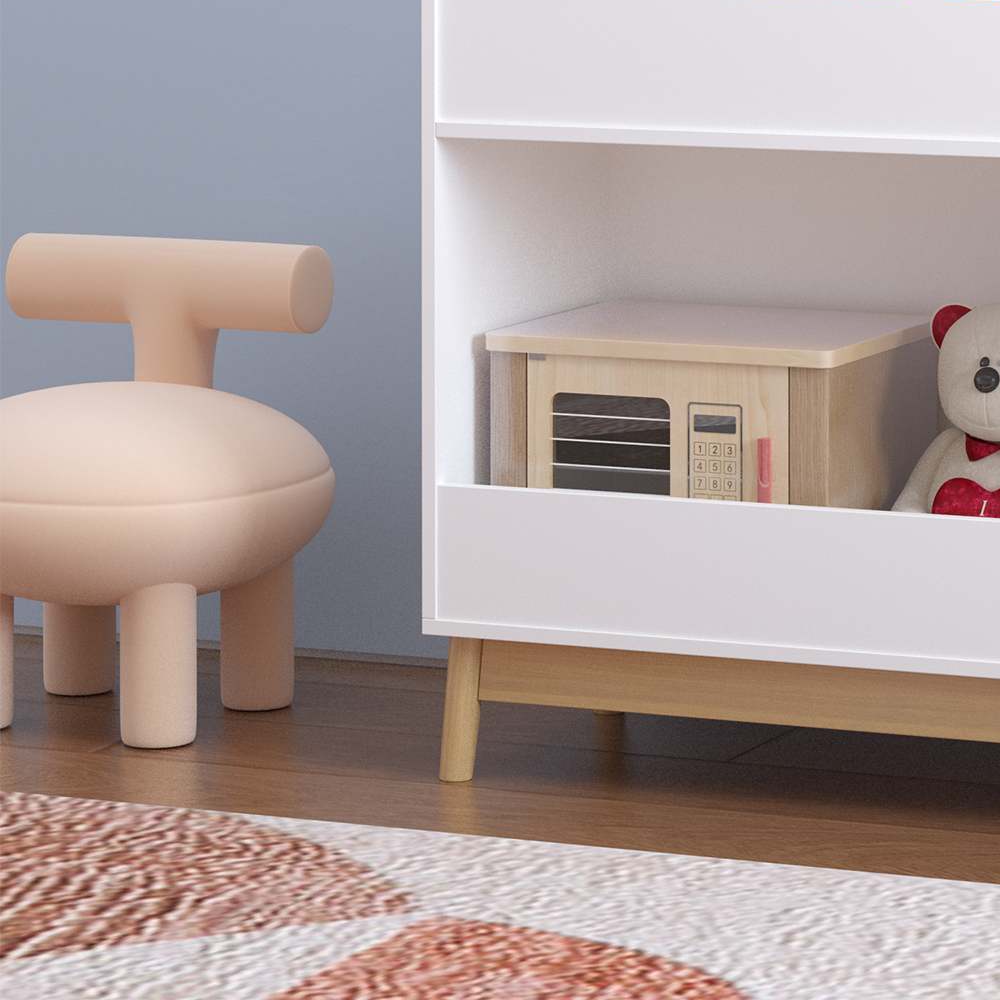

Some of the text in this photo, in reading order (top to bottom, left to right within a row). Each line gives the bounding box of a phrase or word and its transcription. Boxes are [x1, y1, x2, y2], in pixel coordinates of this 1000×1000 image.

[712, 446, 718, 454] 2
[727, 447, 733, 455] 3
[697, 462, 732, 472] 4 5 6
[697, 479, 733, 489] 7 8 9
